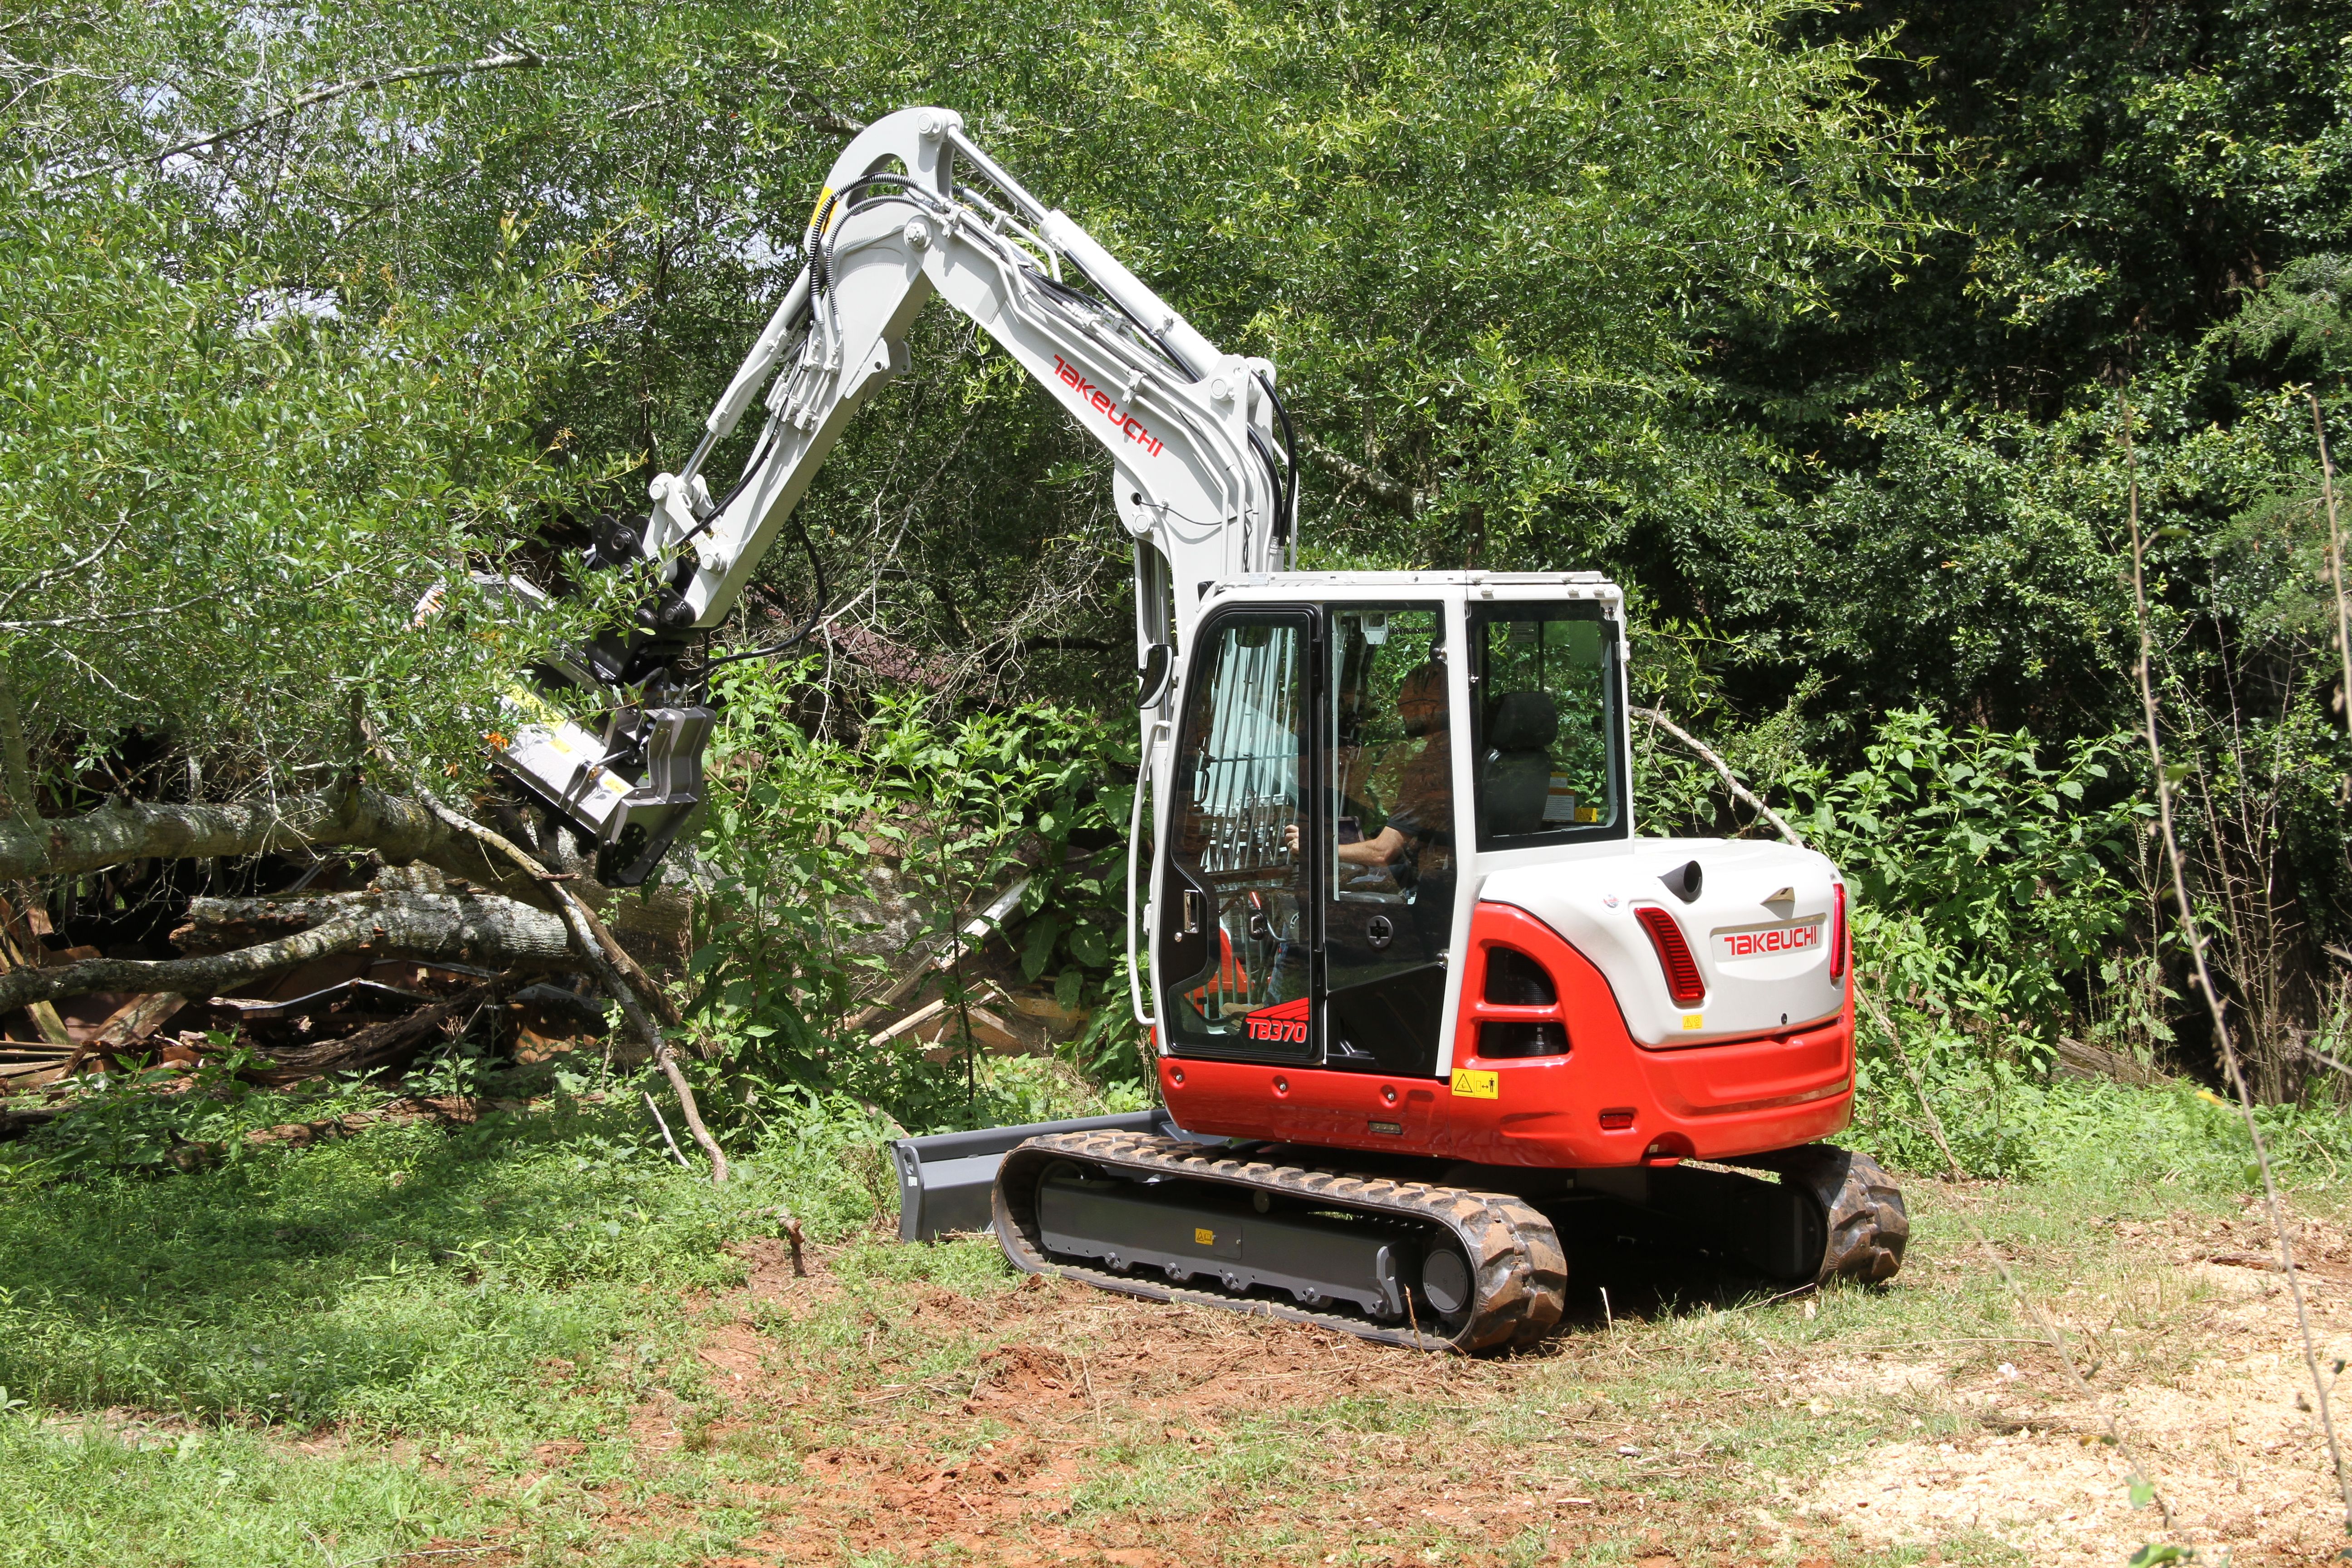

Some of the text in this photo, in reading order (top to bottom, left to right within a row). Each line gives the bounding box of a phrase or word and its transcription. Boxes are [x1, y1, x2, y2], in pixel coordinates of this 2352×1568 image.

[1054, 354, 1163, 458] TAKEUCHI
[1724, 926, 1816, 956] TAKEUCHI
[1245, 1018, 1307, 1043] TB370
